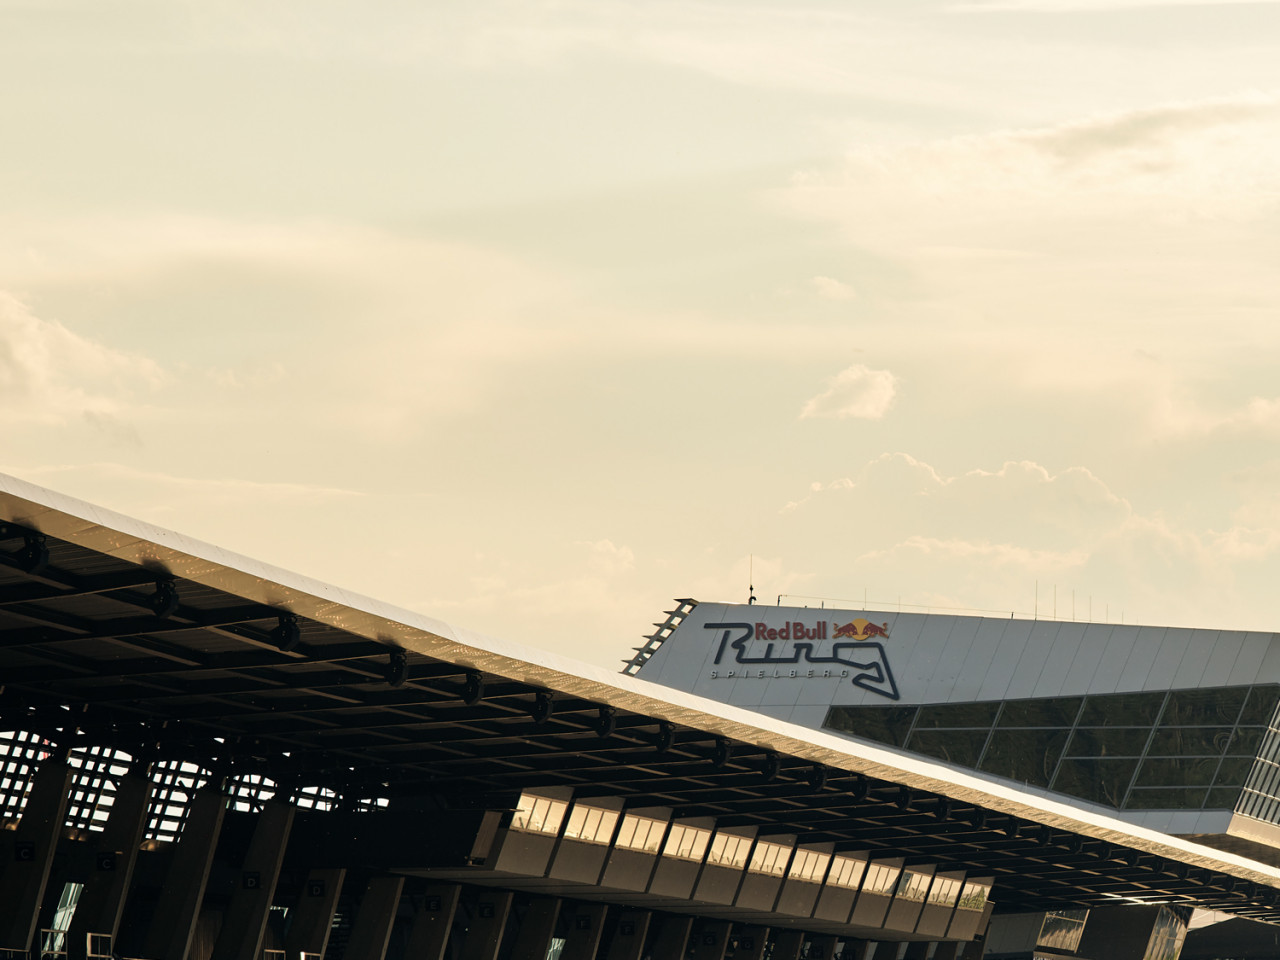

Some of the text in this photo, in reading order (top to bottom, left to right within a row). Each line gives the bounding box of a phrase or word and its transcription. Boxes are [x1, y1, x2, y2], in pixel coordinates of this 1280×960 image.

[755, 621, 826, 640] Red Bull
[710, 669, 848, 680] SPIELBERG
